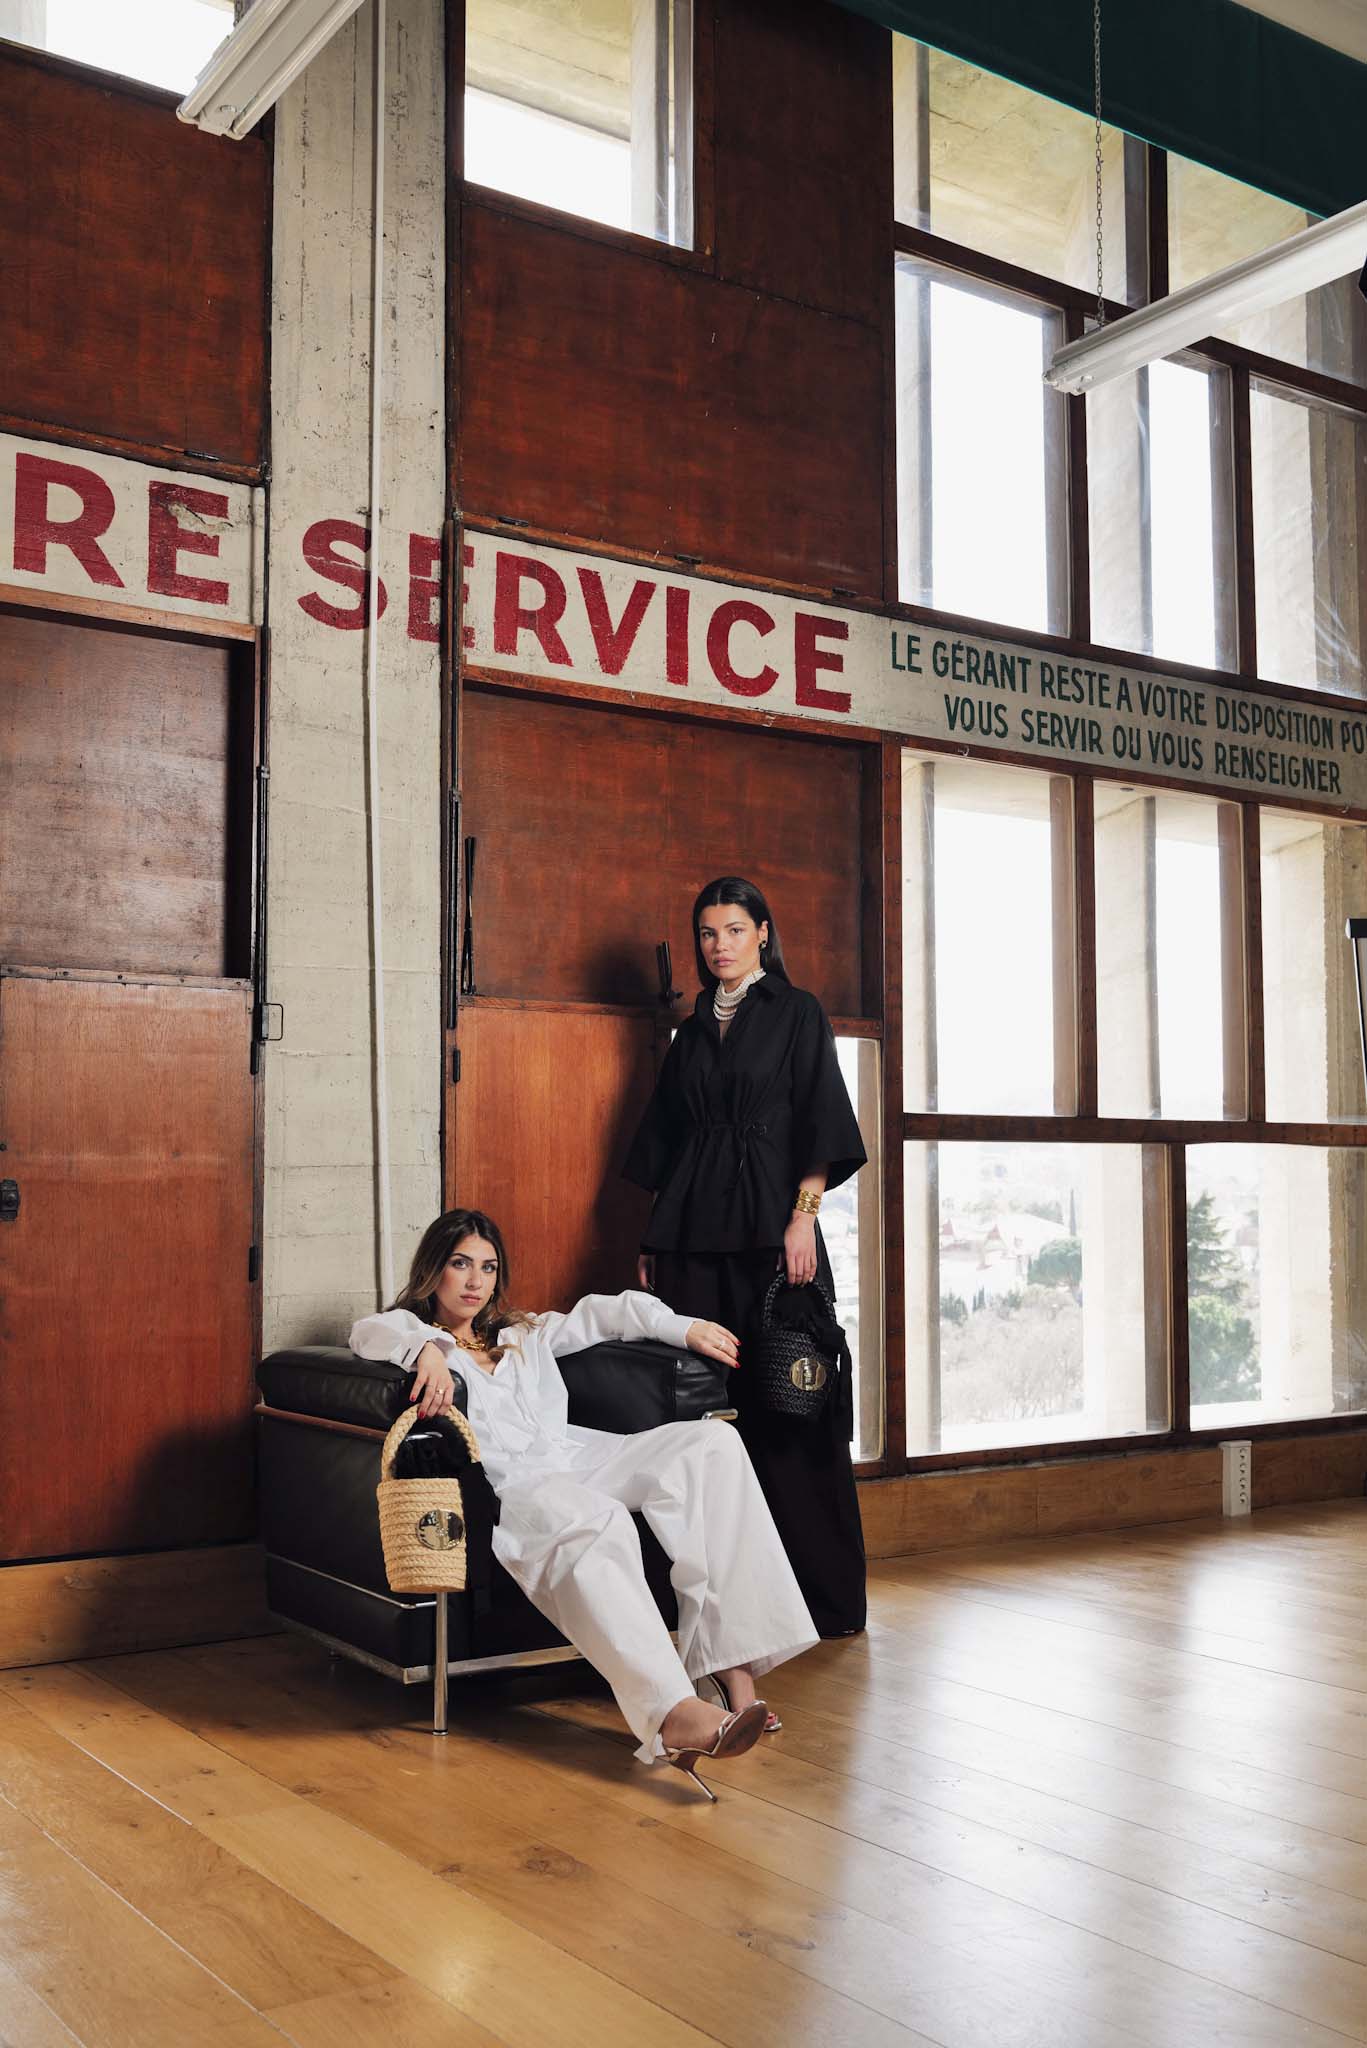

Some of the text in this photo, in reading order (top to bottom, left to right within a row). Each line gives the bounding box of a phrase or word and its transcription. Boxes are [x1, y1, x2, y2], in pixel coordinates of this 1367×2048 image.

[13, 452, 852, 714] RE SERVICE
[891, 631, 1367, 755] LE GÉRANT RESTE A VOTRE DISPOSITION PO
[944, 694, 1341, 794] VOUS SERVIR OU VOUS RENSEIGNER
